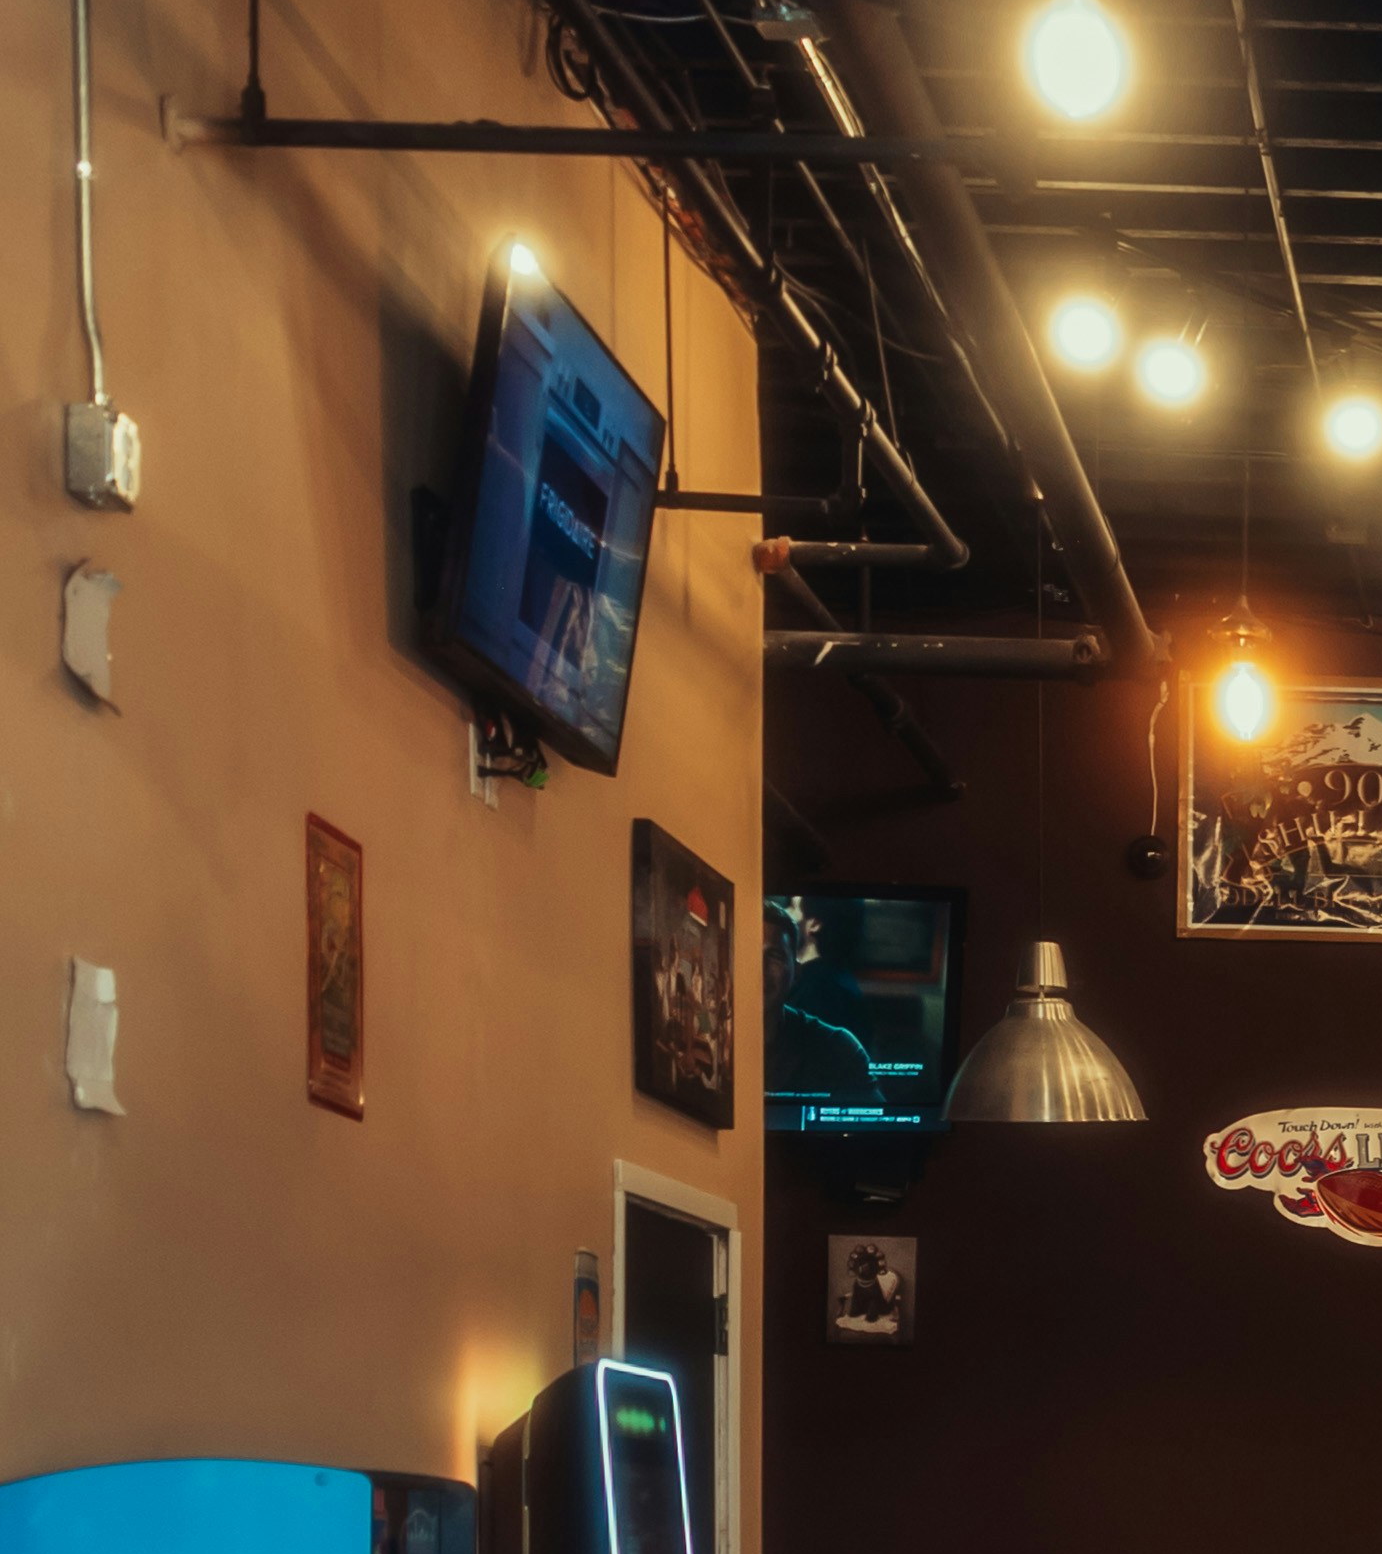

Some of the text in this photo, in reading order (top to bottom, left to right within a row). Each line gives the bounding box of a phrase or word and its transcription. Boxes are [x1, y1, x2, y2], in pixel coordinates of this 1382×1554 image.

[1278, 1120, 1317, 1134] Touch
[1319, 1118, 1360, 1132] Down!
[1210, 1127, 1354, 1179] Coors
